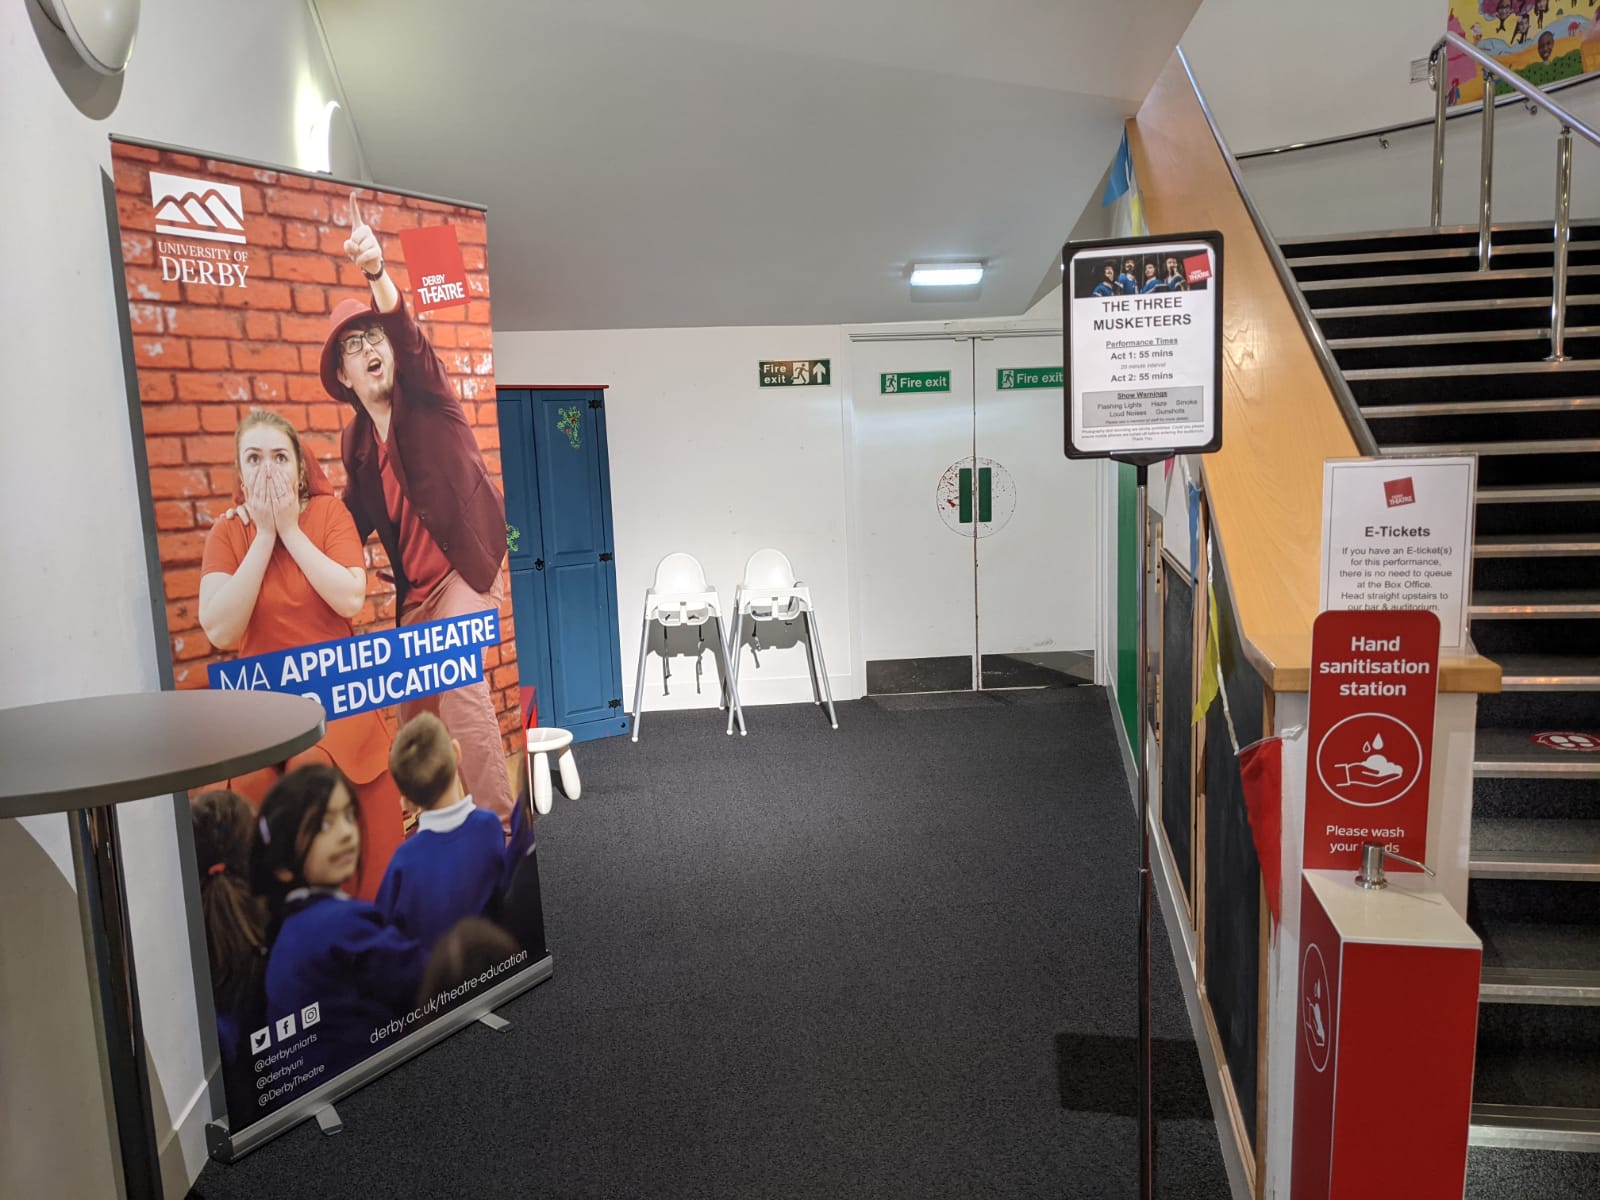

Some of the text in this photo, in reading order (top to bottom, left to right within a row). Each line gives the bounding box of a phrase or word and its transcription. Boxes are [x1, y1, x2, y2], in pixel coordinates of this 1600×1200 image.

[158, 241, 248, 262] UNIVERSITY OF
[159, 255, 249, 288] DERBY
[422, 274, 446, 287] DERBY
[417, 281, 465, 305] THEATRE
[1102, 297, 1183, 313] THE THREE
[1093, 313, 1192, 331] MUSKETEERS
[1105, 337, 1178, 349] Performance Times
[1110, 349, 1174, 361] Act 1: 55 mins
[763, 364, 787, 374] Fire
[763, 374, 787, 385] exit
[900, 376, 947, 388] Fire exit
[1016, 371, 1063, 384] Fire exit
[1110, 371, 1174, 383] Act 2: 55 mins
[1364, 525, 1431, 538] E-Tickets
[1350, 548, 1366, 557] you
[1368, 547, 1391, 555] have
[1406, 546, 1452, 556] E-ticket(s)
[1350, 558, 1363, 566] for
[1364, 558, 1381, 566] this
[1339, 569, 1362, 578] there
[1364, 569, 1372, 578] is
[1388, 569, 1411, 578] need
[1412, 569, 1422, 577] to
[1424, 570, 1453, 579] queue
[1357, 580, 1433, 589] at the Box Office.
[1341, 591, 1449, 602] Head straight upstairs to
[1347, 603, 1363, 611] our
[1364, 602, 1380, 611] bar
[1382, 602, 1389, 611] &
[1351, 635, 1401, 652] Hand
[220, 615, 496, 691] MA APPLIED THEATRE
[1319, 658, 1430, 675] sanitisation
[331, 654, 478, 714] EDUCATION
[1339, 681, 1407, 697] station
[1326, 825, 1405, 838] Please wash
[1329, 843, 1359, 854] your
[369, 949, 528, 1044] derby.ac.uk/theatre-education
[254, 1033, 318, 1073] @derbyuniarts
[256, 1055, 305, 1089] @derbyuni
[258, 1064, 325, 1106] @DerbyTheatre
